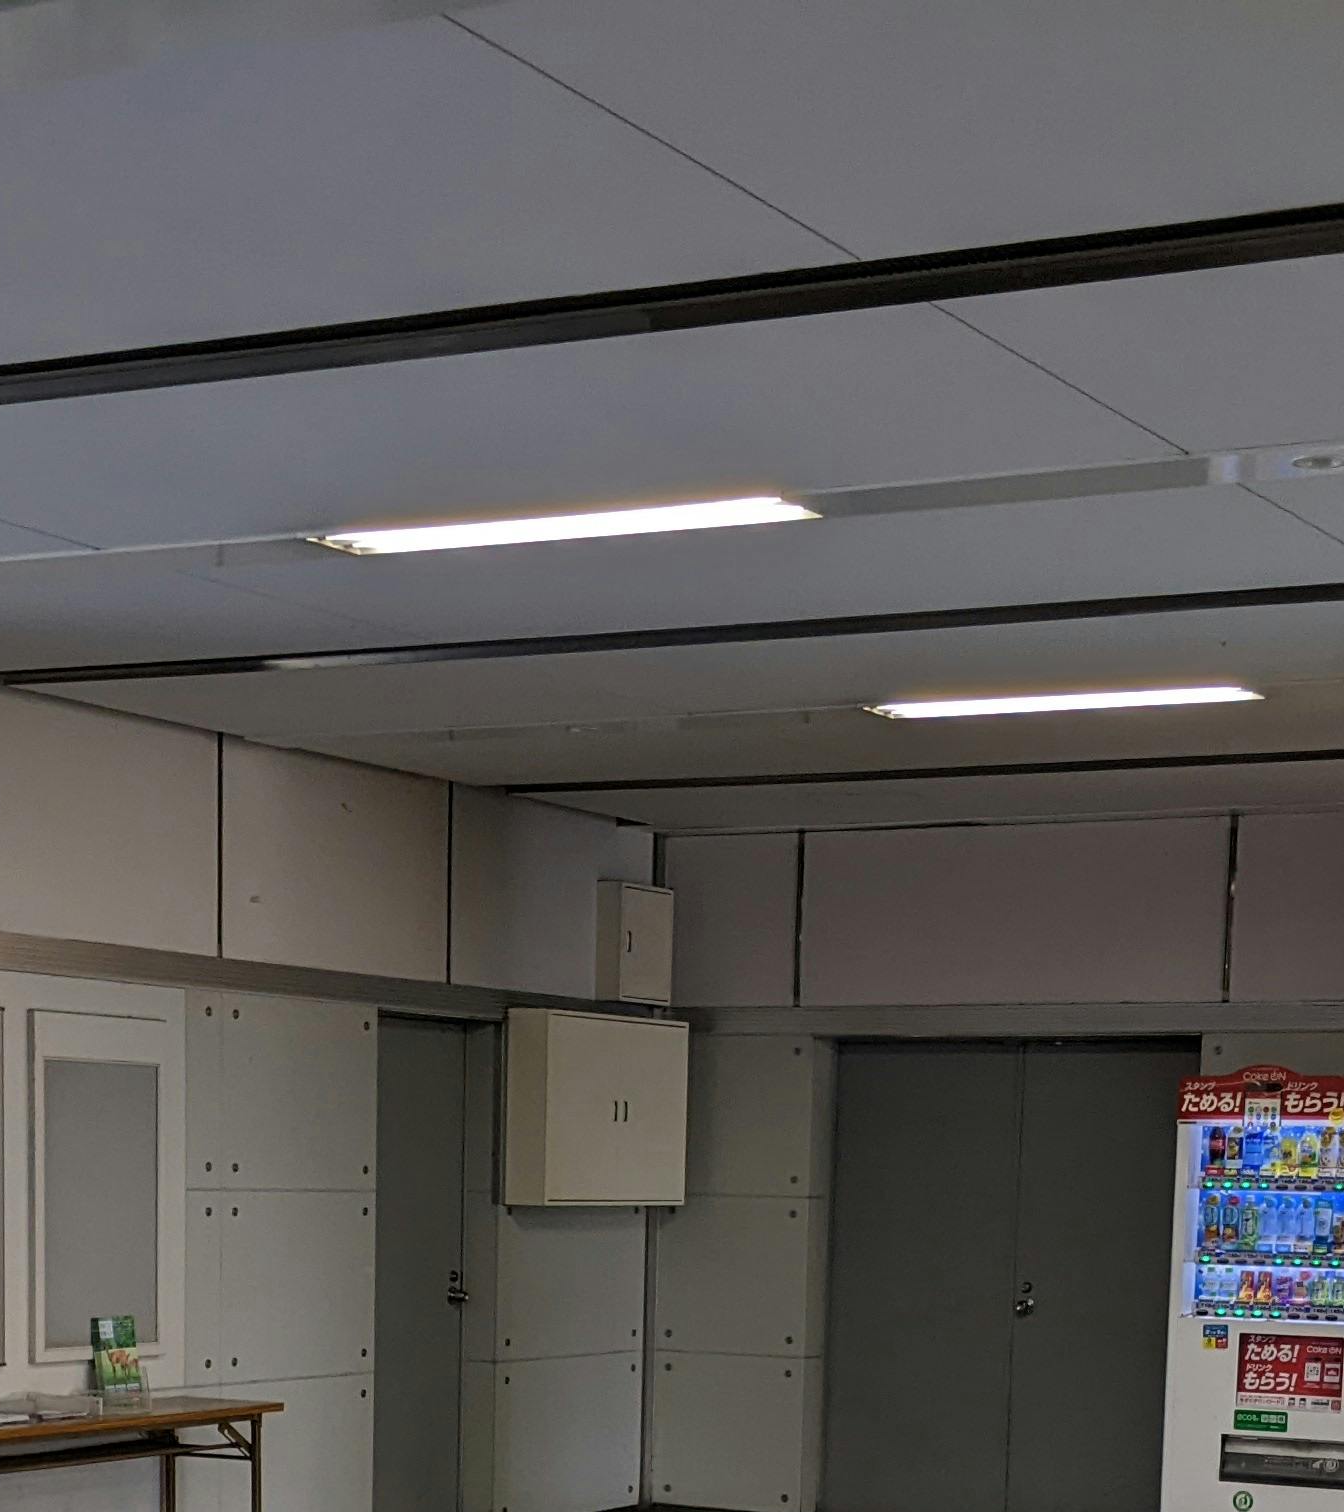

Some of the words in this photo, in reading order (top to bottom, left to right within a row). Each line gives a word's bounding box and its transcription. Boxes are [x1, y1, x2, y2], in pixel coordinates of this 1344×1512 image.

[1181, 1091, 1242, 1113] ためる!
[1244, 1343, 1301, 1364] ためる!
[1243, 1372, 1299, 1392] もらう!
